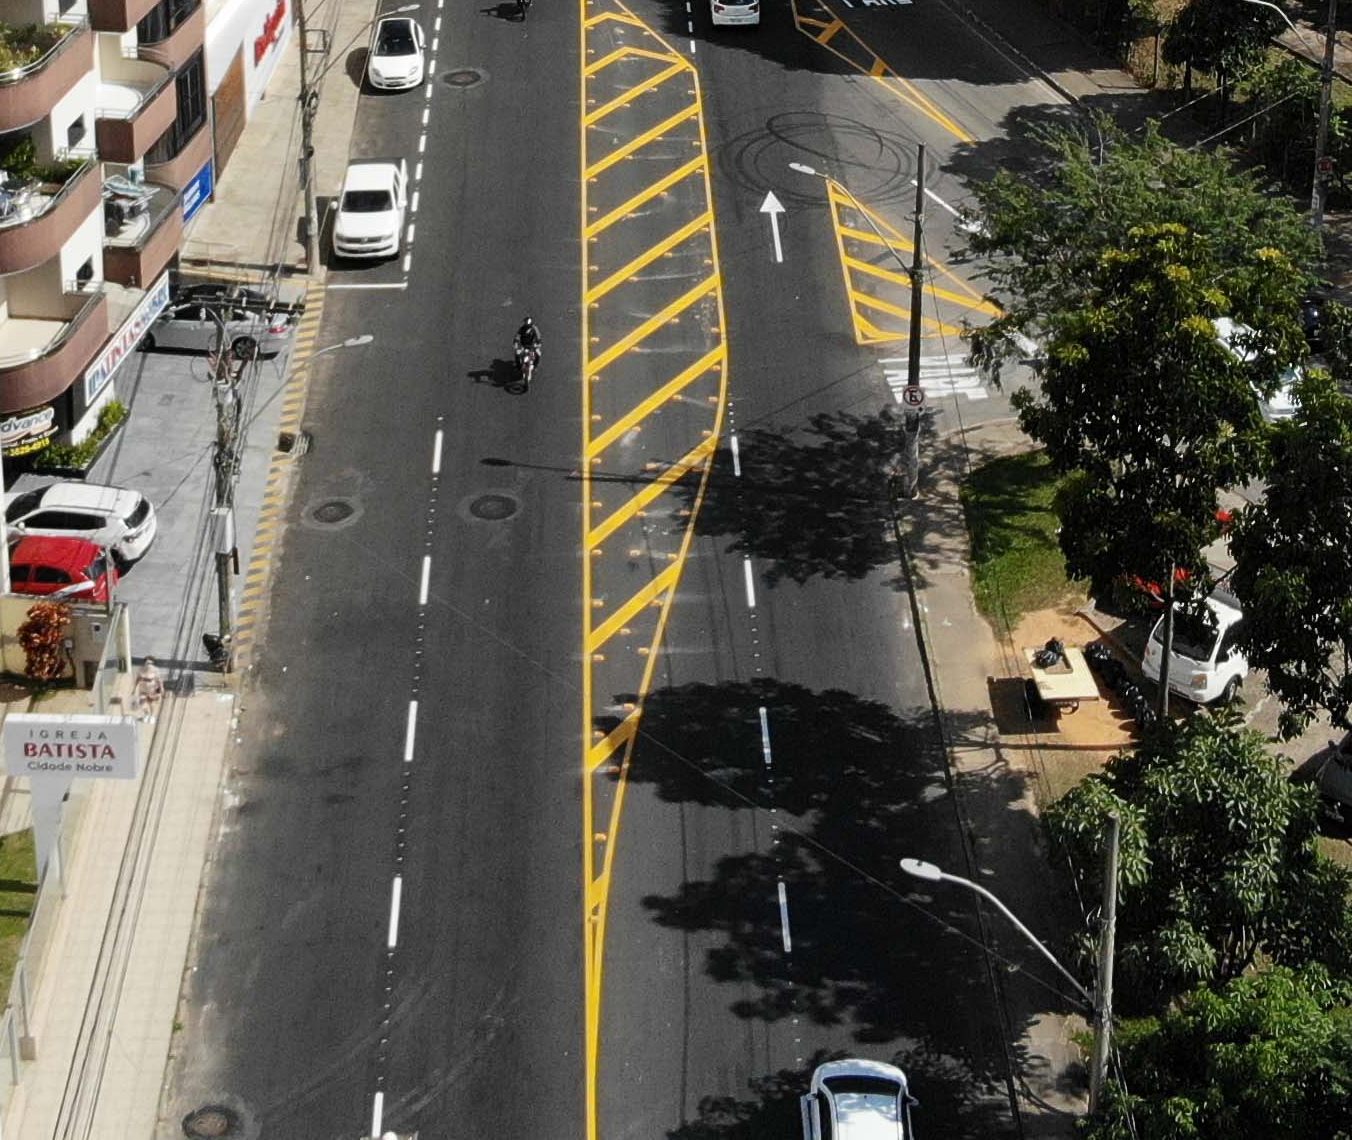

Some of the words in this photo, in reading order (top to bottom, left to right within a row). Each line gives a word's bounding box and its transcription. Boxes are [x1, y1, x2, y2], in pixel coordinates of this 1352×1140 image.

[29, 729, 108, 740] IGREJA
[23, 742, 116, 759] BATISTA
[27, 761, 73, 771] Cidade
[76, 763, 114, 772] Nobre
